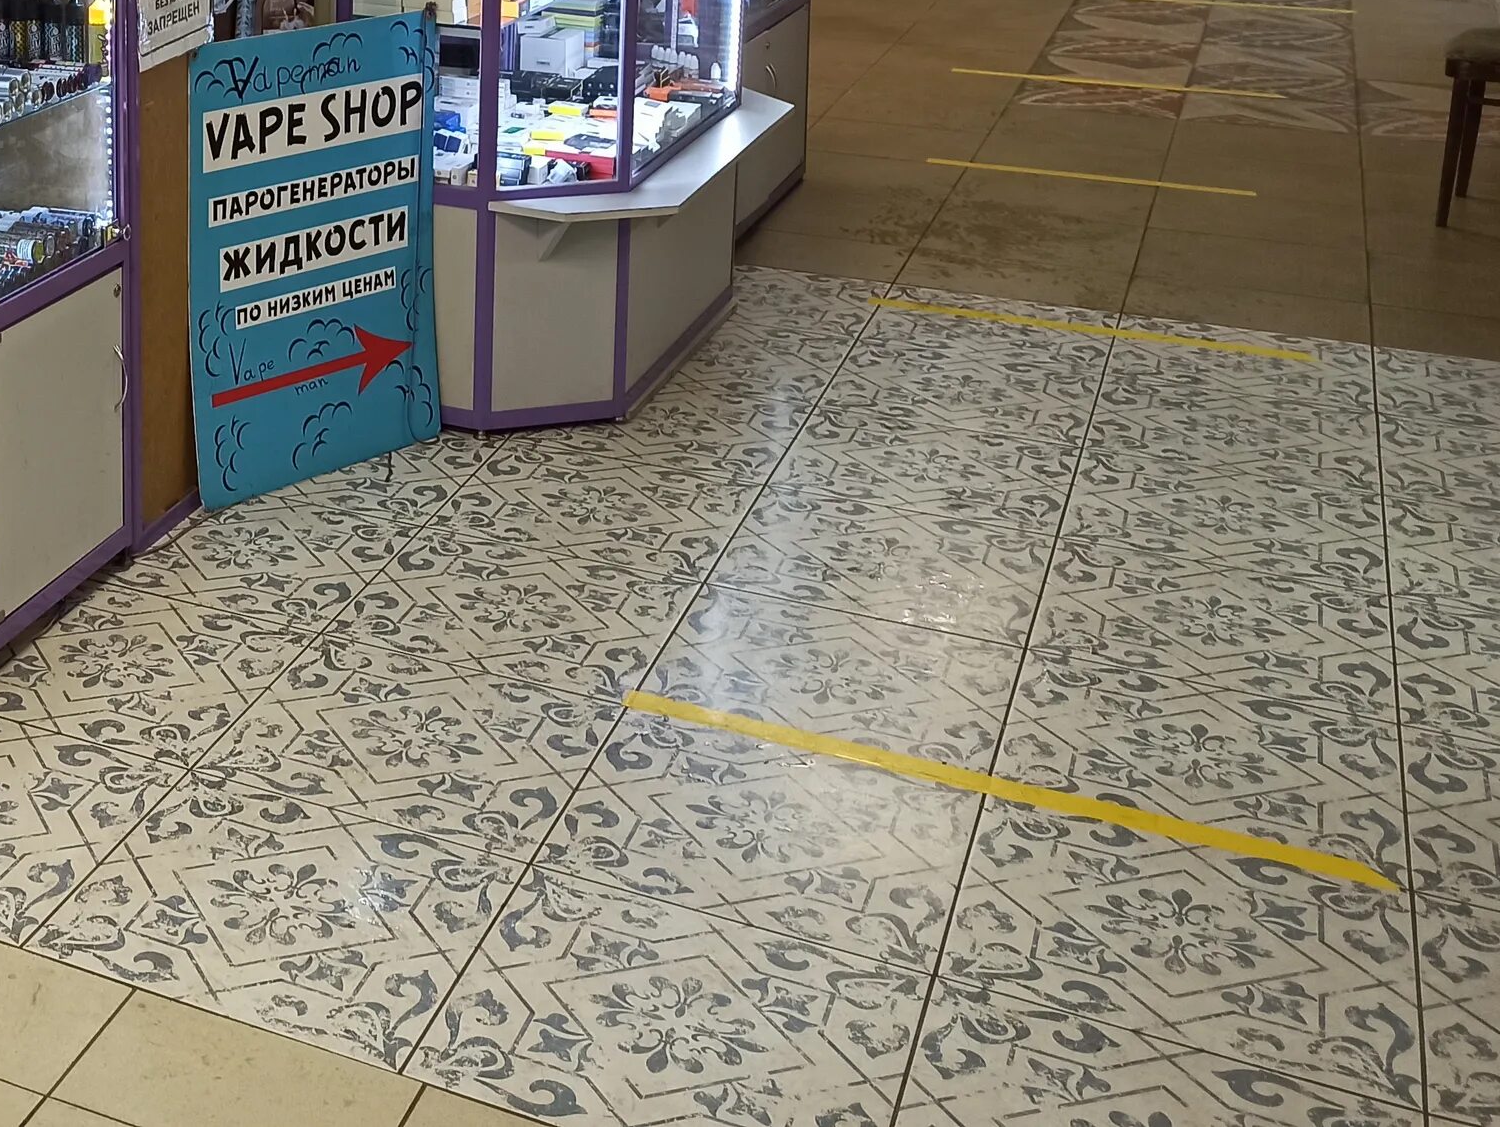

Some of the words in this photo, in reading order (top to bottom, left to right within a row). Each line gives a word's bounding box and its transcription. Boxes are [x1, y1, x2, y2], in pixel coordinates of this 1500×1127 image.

[147, 1, 200, 35] ЗАПРЕЩЕН
[205, 103, 306, 162] VAPE
[321, 80, 423, 143] SHOP
[212, 157, 416, 222] ПАРОГЕНЕРАТОРЫ
[222, 211, 407, 283] ЖИДКОСТИ
[236, 302, 261, 327] ПО
[267, 285, 337, 320] НИЗКИМ
[342, 269, 396, 304] ЦЕНАМ
